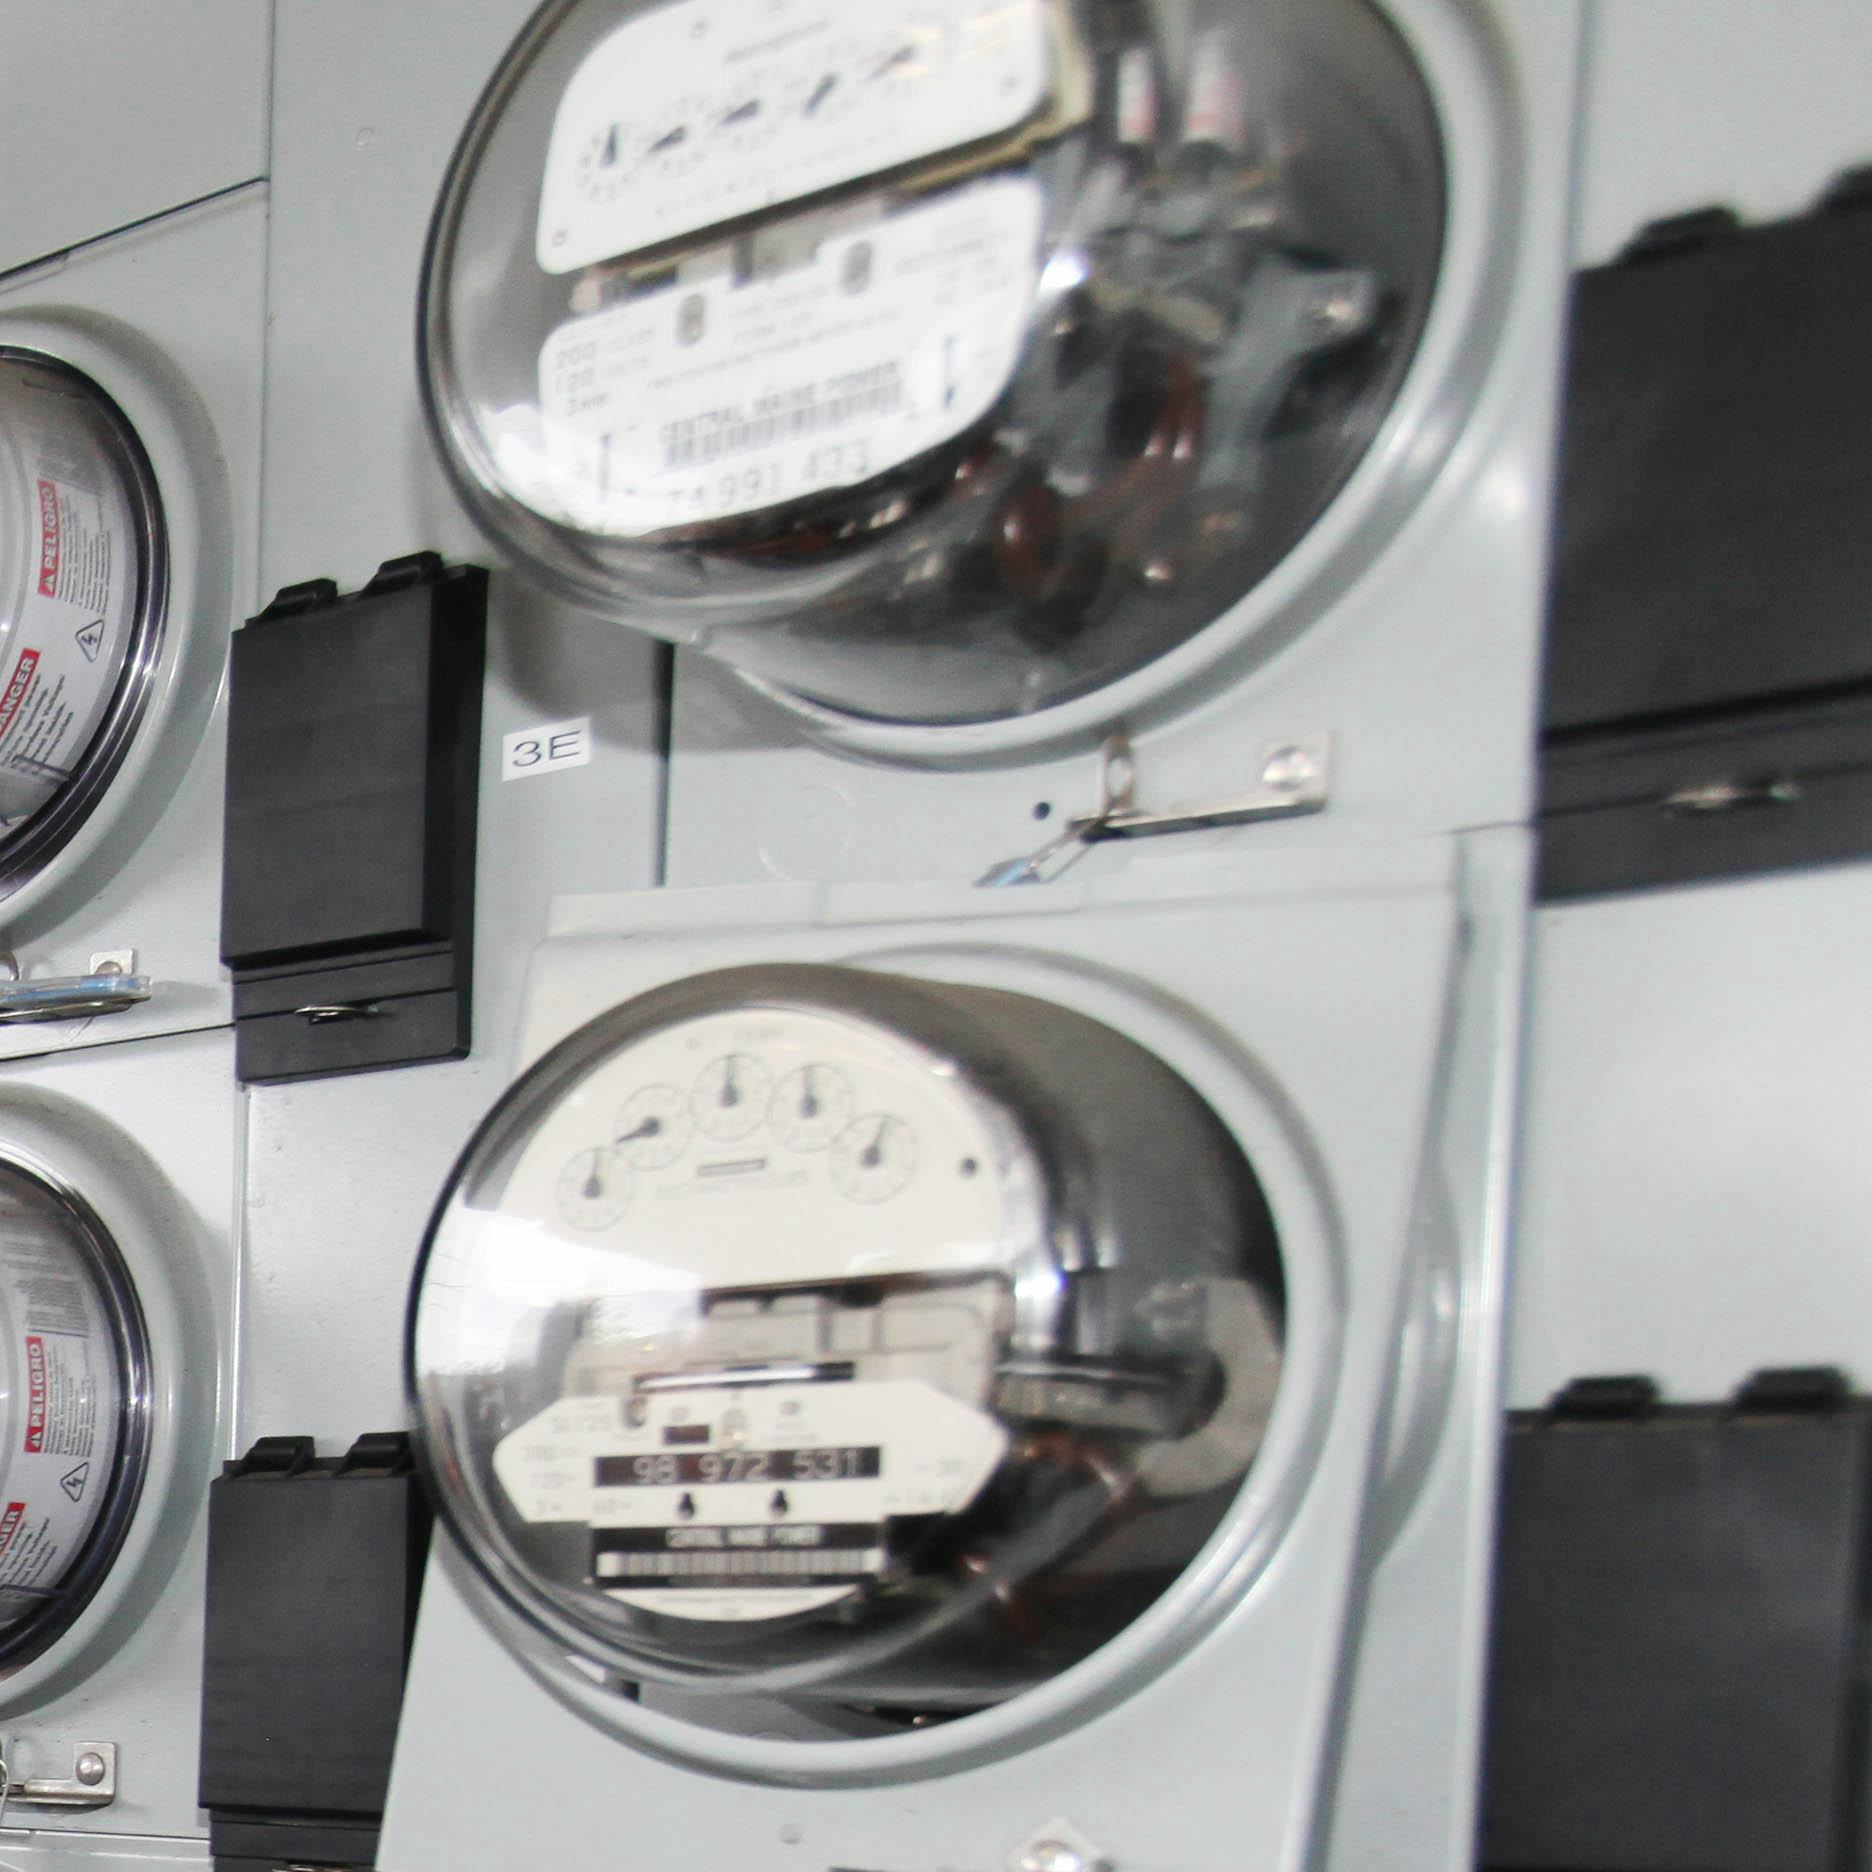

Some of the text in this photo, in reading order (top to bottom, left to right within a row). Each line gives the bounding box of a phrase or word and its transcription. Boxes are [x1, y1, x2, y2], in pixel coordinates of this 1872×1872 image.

[659, 405, 743, 444] CENTRAL
[824, 360, 899, 395] POWER
[42, 485, 60, 570] PELIGRO
[512, 730, 582, 768] 3E
[30, 1342, 45, 1428] PELIGRO
[632, 1447, 859, 1485] 98 972 531
